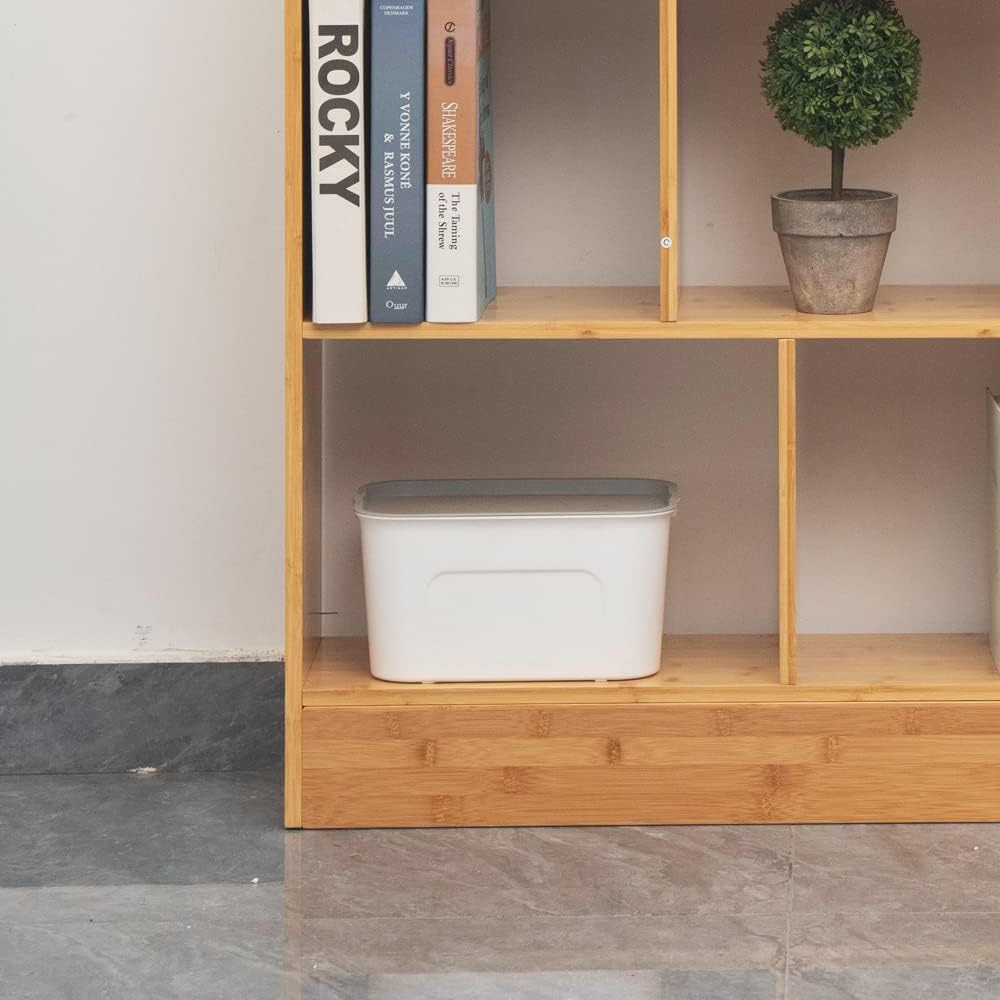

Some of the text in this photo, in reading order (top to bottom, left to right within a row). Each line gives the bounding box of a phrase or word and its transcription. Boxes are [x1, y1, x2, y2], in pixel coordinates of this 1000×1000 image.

[317, 24, 361, 208] ROCKY
[440, 102, 459, 179] SHAKESPEARE
[382, 132, 395, 239] & RASMUS JUUL
[399, 152, 413, 189] KONÉ
[438, 193, 448, 250] of the Shrew
[448, 192, 461, 250] The Taming
